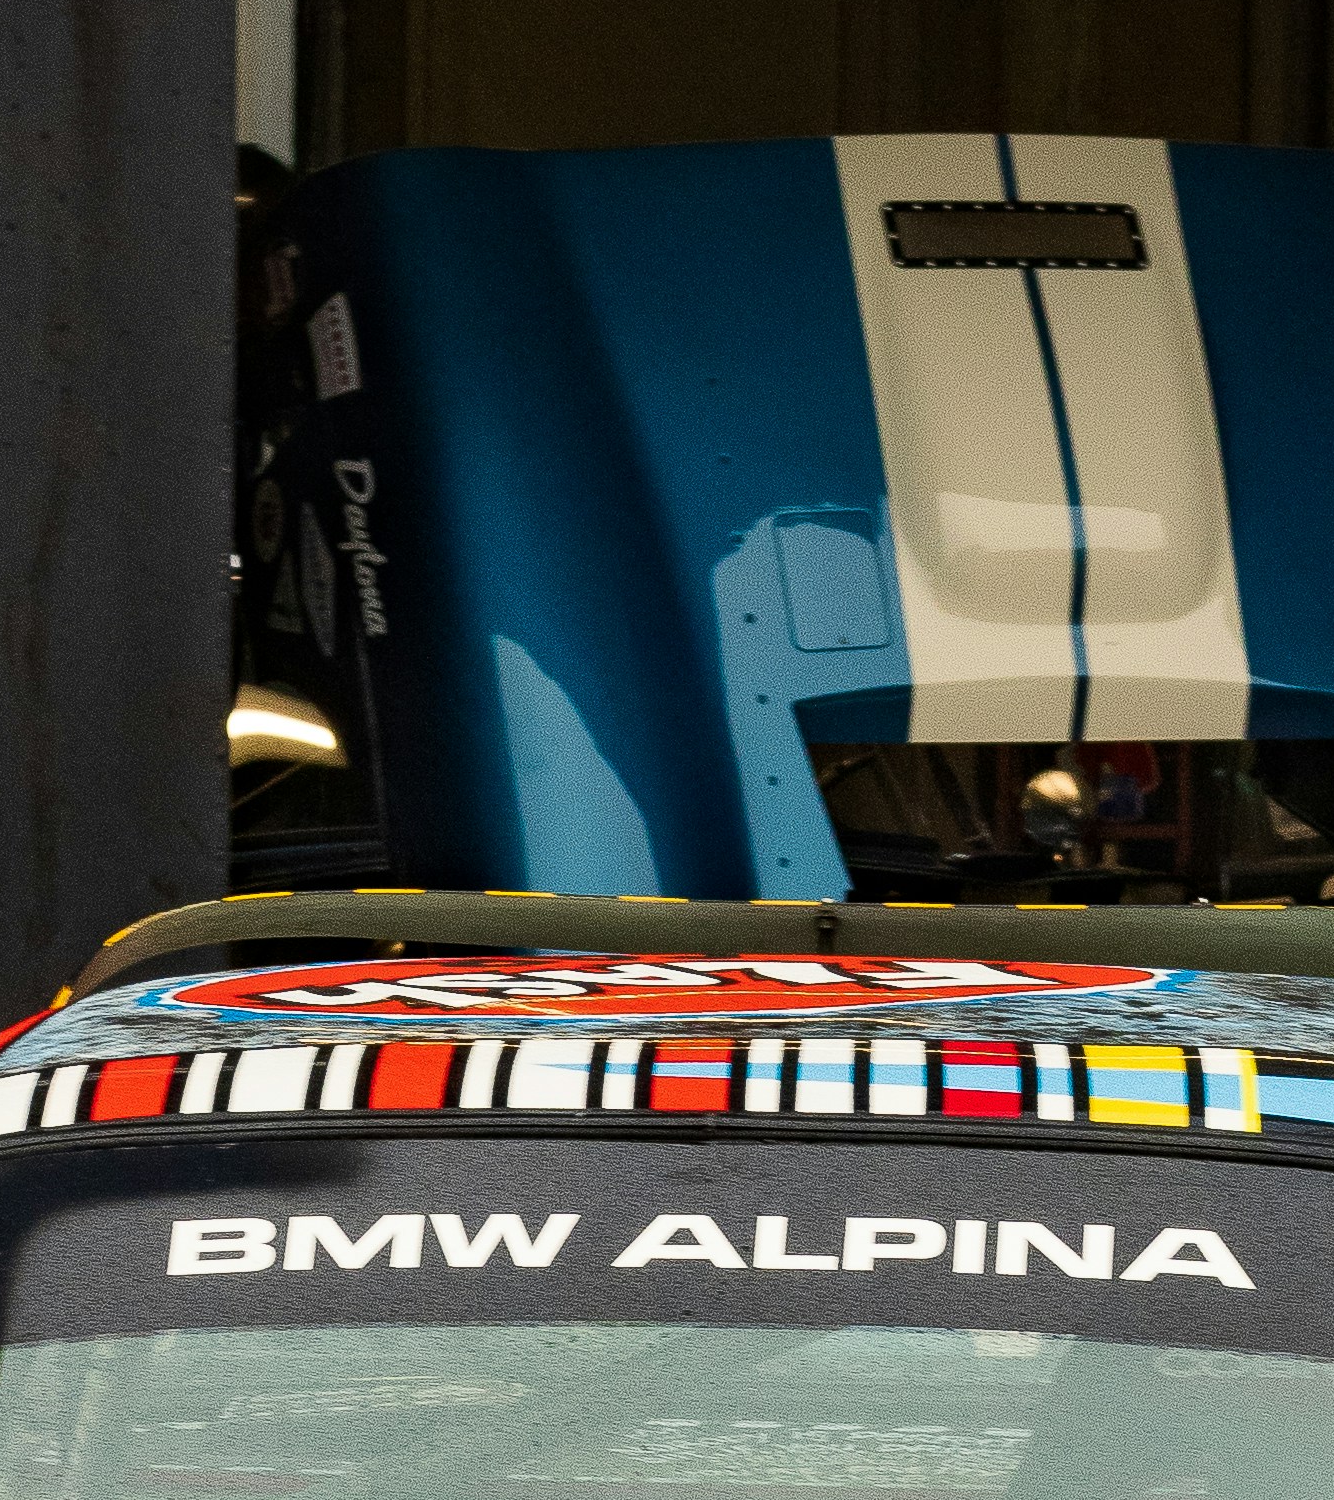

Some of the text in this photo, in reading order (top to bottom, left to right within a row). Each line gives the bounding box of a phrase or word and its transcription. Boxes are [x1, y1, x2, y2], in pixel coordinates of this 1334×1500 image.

[333, 457, 390, 638] Daytona
[165, 1212, 1258, 1289] BMW ALPINA
